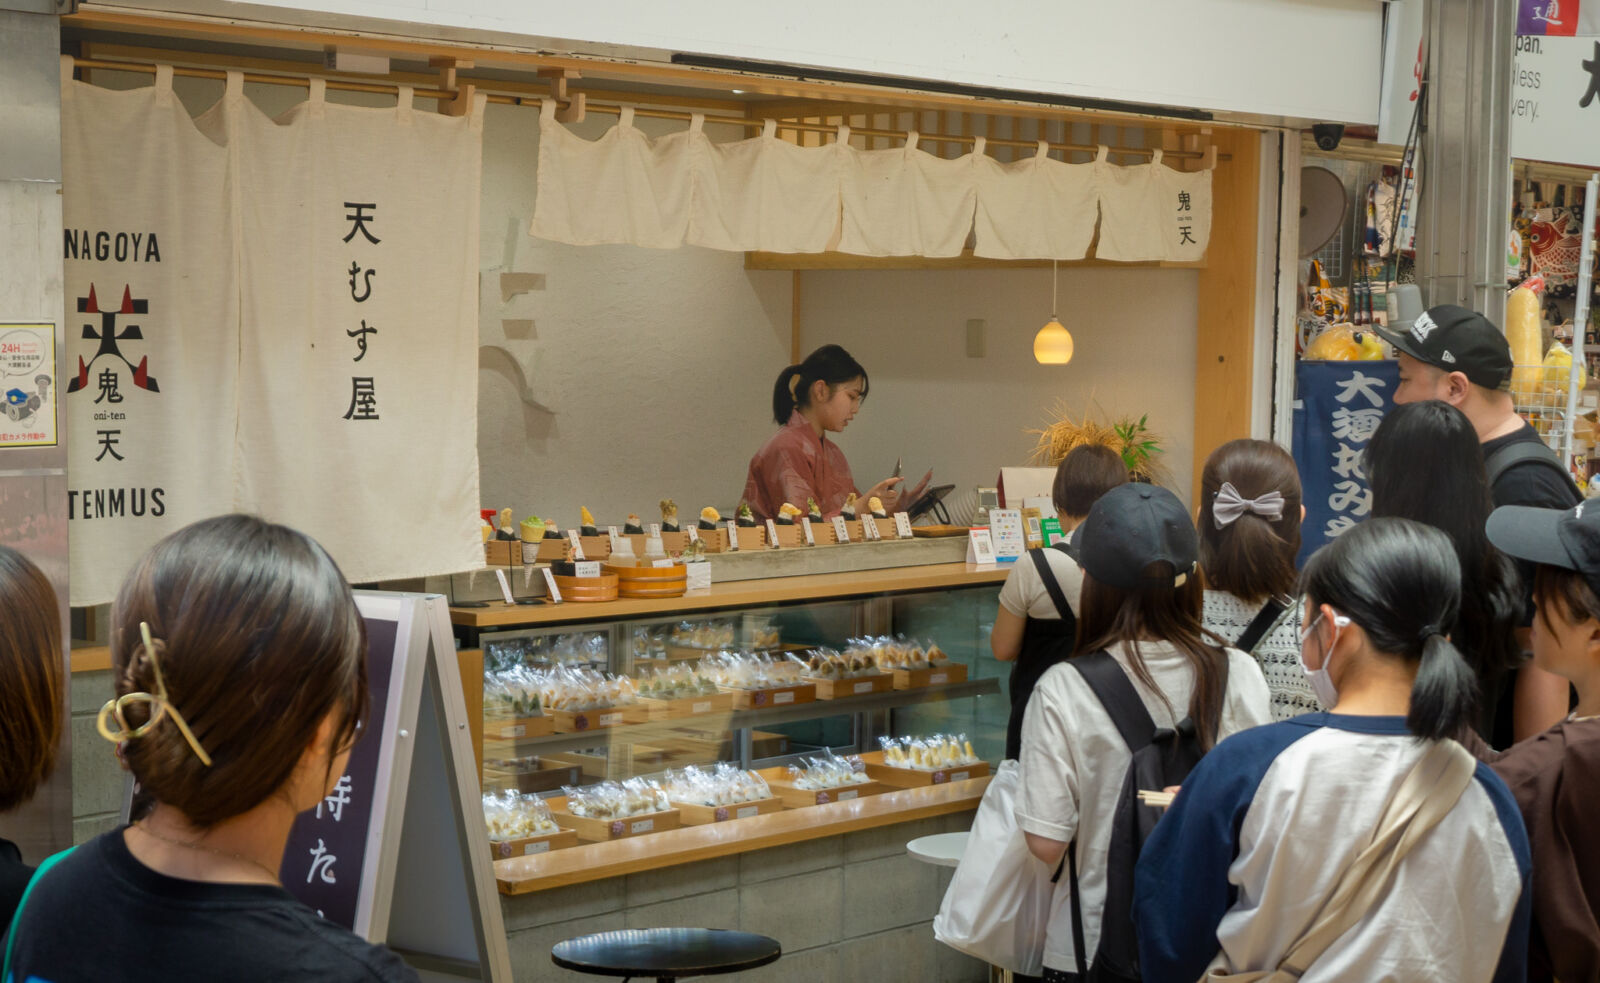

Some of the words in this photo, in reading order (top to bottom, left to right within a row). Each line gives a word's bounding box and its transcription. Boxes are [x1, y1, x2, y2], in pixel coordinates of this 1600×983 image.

[1177, 190, 1191, 211] 鬼
[64, 229, 161, 262] NAGOYA
[1179, 226, 1196, 245] 天
[342, 202, 382, 420] 天むす屋
[1, 343, 21, 353] 24H
[94, 368, 124, 405] 鬼
[93, 410, 126, 421] oni-ten
[95, 429, 125, 462] 天
[68, 488, 165, 520] TENMUS
